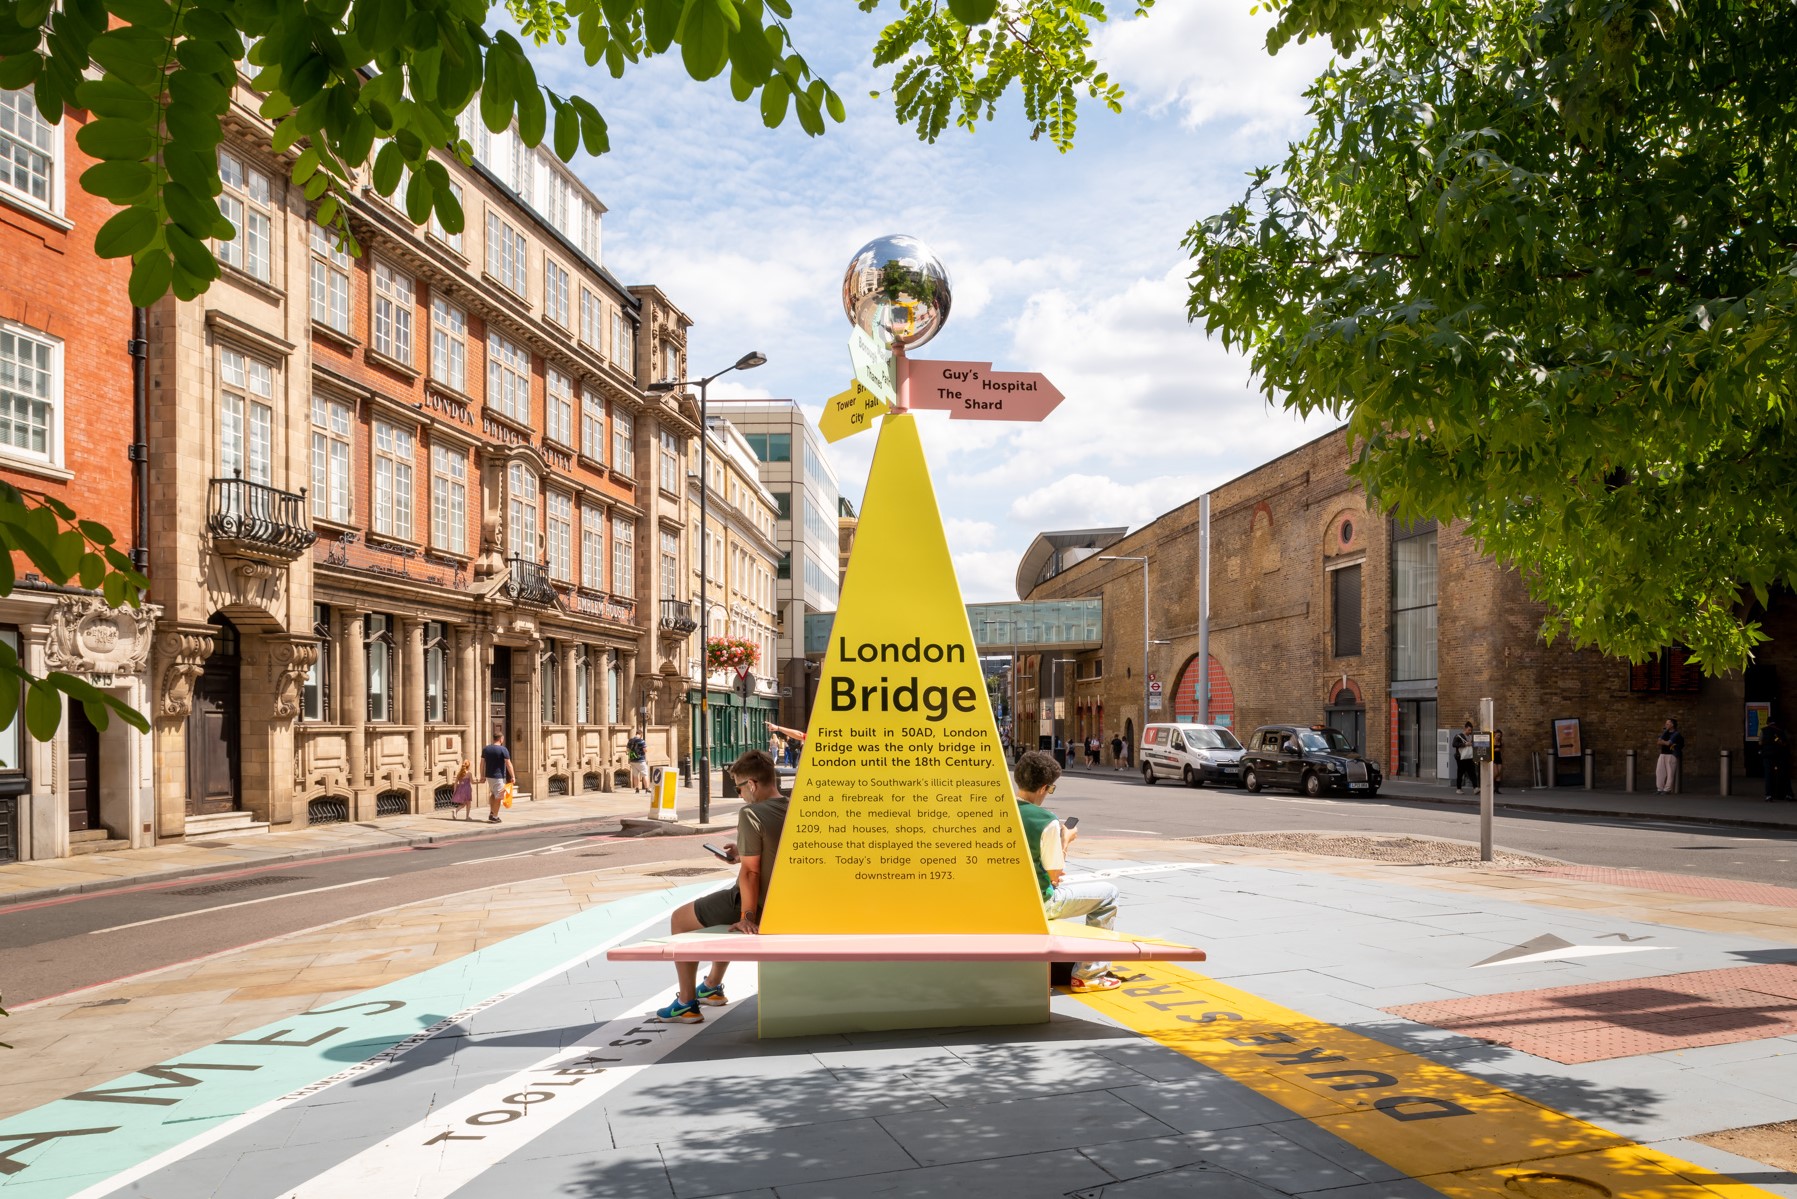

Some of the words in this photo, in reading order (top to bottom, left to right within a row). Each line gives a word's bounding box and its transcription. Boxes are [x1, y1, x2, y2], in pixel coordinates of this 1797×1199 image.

[865, 365, 883, 390] Thames
[942, 368, 979, 383] Guy's
[982, 379, 1038, 393] Hospital
[837, 397, 857, 412] Tower
[937, 388, 962, 399] The
[964, 398, 1003, 410] Shard
[426, 390, 475, 427] LONDON
[483, 418, 523, 445] BRIDGE
[850, 412, 865, 425] City
[864, 396, 879, 410] Hall
[605, 603, 625, 619] HOUSE
[840, 636, 965, 663] London
[831, 676, 976, 722] Bridge
[818, 727, 843, 738] First
[850, 727, 877, 738] built
[883, 727, 894, 737] in
[901, 727, 936, 738] 50AD,
[943, 727, 987, 738] London
[815, 742, 853, 754] Bridge
[857, 744, 880, 752] was
[884, 742, 904, 752] the
[908, 742, 934, 754] only
[938, 742, 976, 754] bridge
[980, 742, 991, 752] in
[812, 757, 856, 767] London
[860, 756, 888, 767] until
[891, 756, 911, 767] the
[915, 756, 941, 767] 18th
[945, 756, 995, 769] Century.
[806, 778, 814, 787] A
[815, 778, 856, 789] gateway
[857, 777, 869, 787] to
[870, 777, 929, 787] Southwark's
[931, 778, 954, 787] illicit
[955, 778, 1001, 789] pleasures
[803, 793, 821, 802] and
[841, 793, 884, 803] firebreak
[891, 793, 906, 803] for
[912, 793, 929, 803] the
[935, 793, 963, 803] Great
[969, 793, 988, 803] Fire
[994, 793, 1006, 803] of
[800, 809, 839, 819] London,
[845, 809, 862, 818] the
[867, 809, 912, 818] medieval
[917, 809, 951, 820] bridge,
[956, 809, 994, 820] opened
[999, 809, 1009, 818] in
[796, 824, 822, 834] 1209,
[828, 824, 847, 834] had
[852, 824, 889, 834] houses,
[895, 824, 926, 835] shops,
[932, 824, 977, 834] churches
[982, 824, 1001, 834] and
[1006, 826, 1013, 834] a
[792, 840, 844, 851] gatehouse
[846, 840, 866, 849] that
[868, 840, 914, 851] displayed
[916, 840, 933, 849] the
[935, 840, 972, 849] severed
[975, 840, 1004, 849] heads
[1006, 840, 1017, 849] of
[789, 855, 826, 865] traitors.
[835, 855, 872, 866] Today's
[880, 855, 911, 866] bridge
[919, 855, 957, 866] opened
[965, 855, 978, 865] 30
[987, 856, 1021, 865] metres
[854, 871, 916, 880] downstream
[918, 871, 927, 880] in
[930, 870, 955, 880] 1973.
[1224, 1031, 1478, 1122] DUKE
[422, 1055, 623, 1146] TOOLEY
